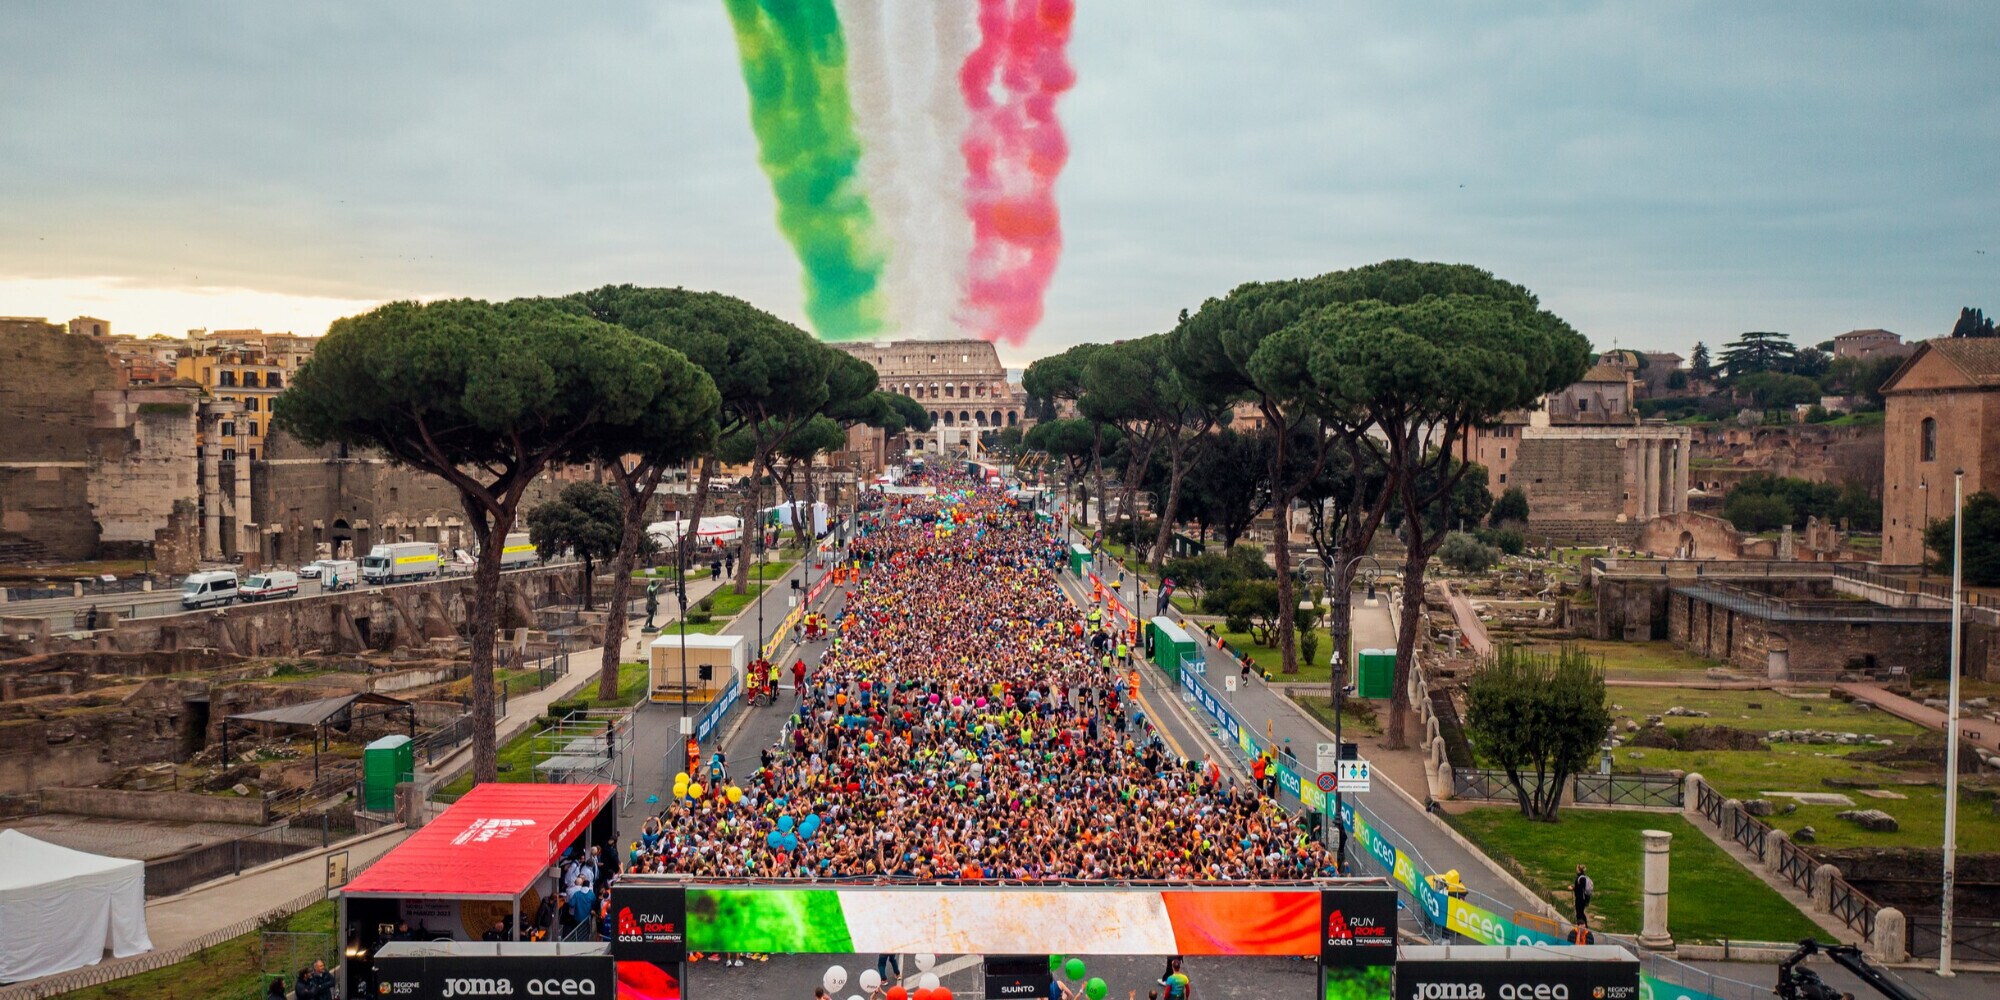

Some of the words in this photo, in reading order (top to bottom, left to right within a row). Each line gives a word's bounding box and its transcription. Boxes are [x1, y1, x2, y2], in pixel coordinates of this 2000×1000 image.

[1281, 770, 1299, 793] acea
[1303, 785, 1326, 810] acea
[1373, 836, 1394, 866] acea
[639, 914, 664, 923] RUN
[1349, 917, 1375, 926] RUN
[644, 923, 675, 932] ROME
[1354, 927, 1386, 936] ROME
[1455, 907, 1505, 945] acea
[1328, 938, 1353, 946] acea
[526, 978, 595, 995] acea
[1001, 985, 1035, 993] SUUNTO
[1499, 983, 1569, 1000] acea
